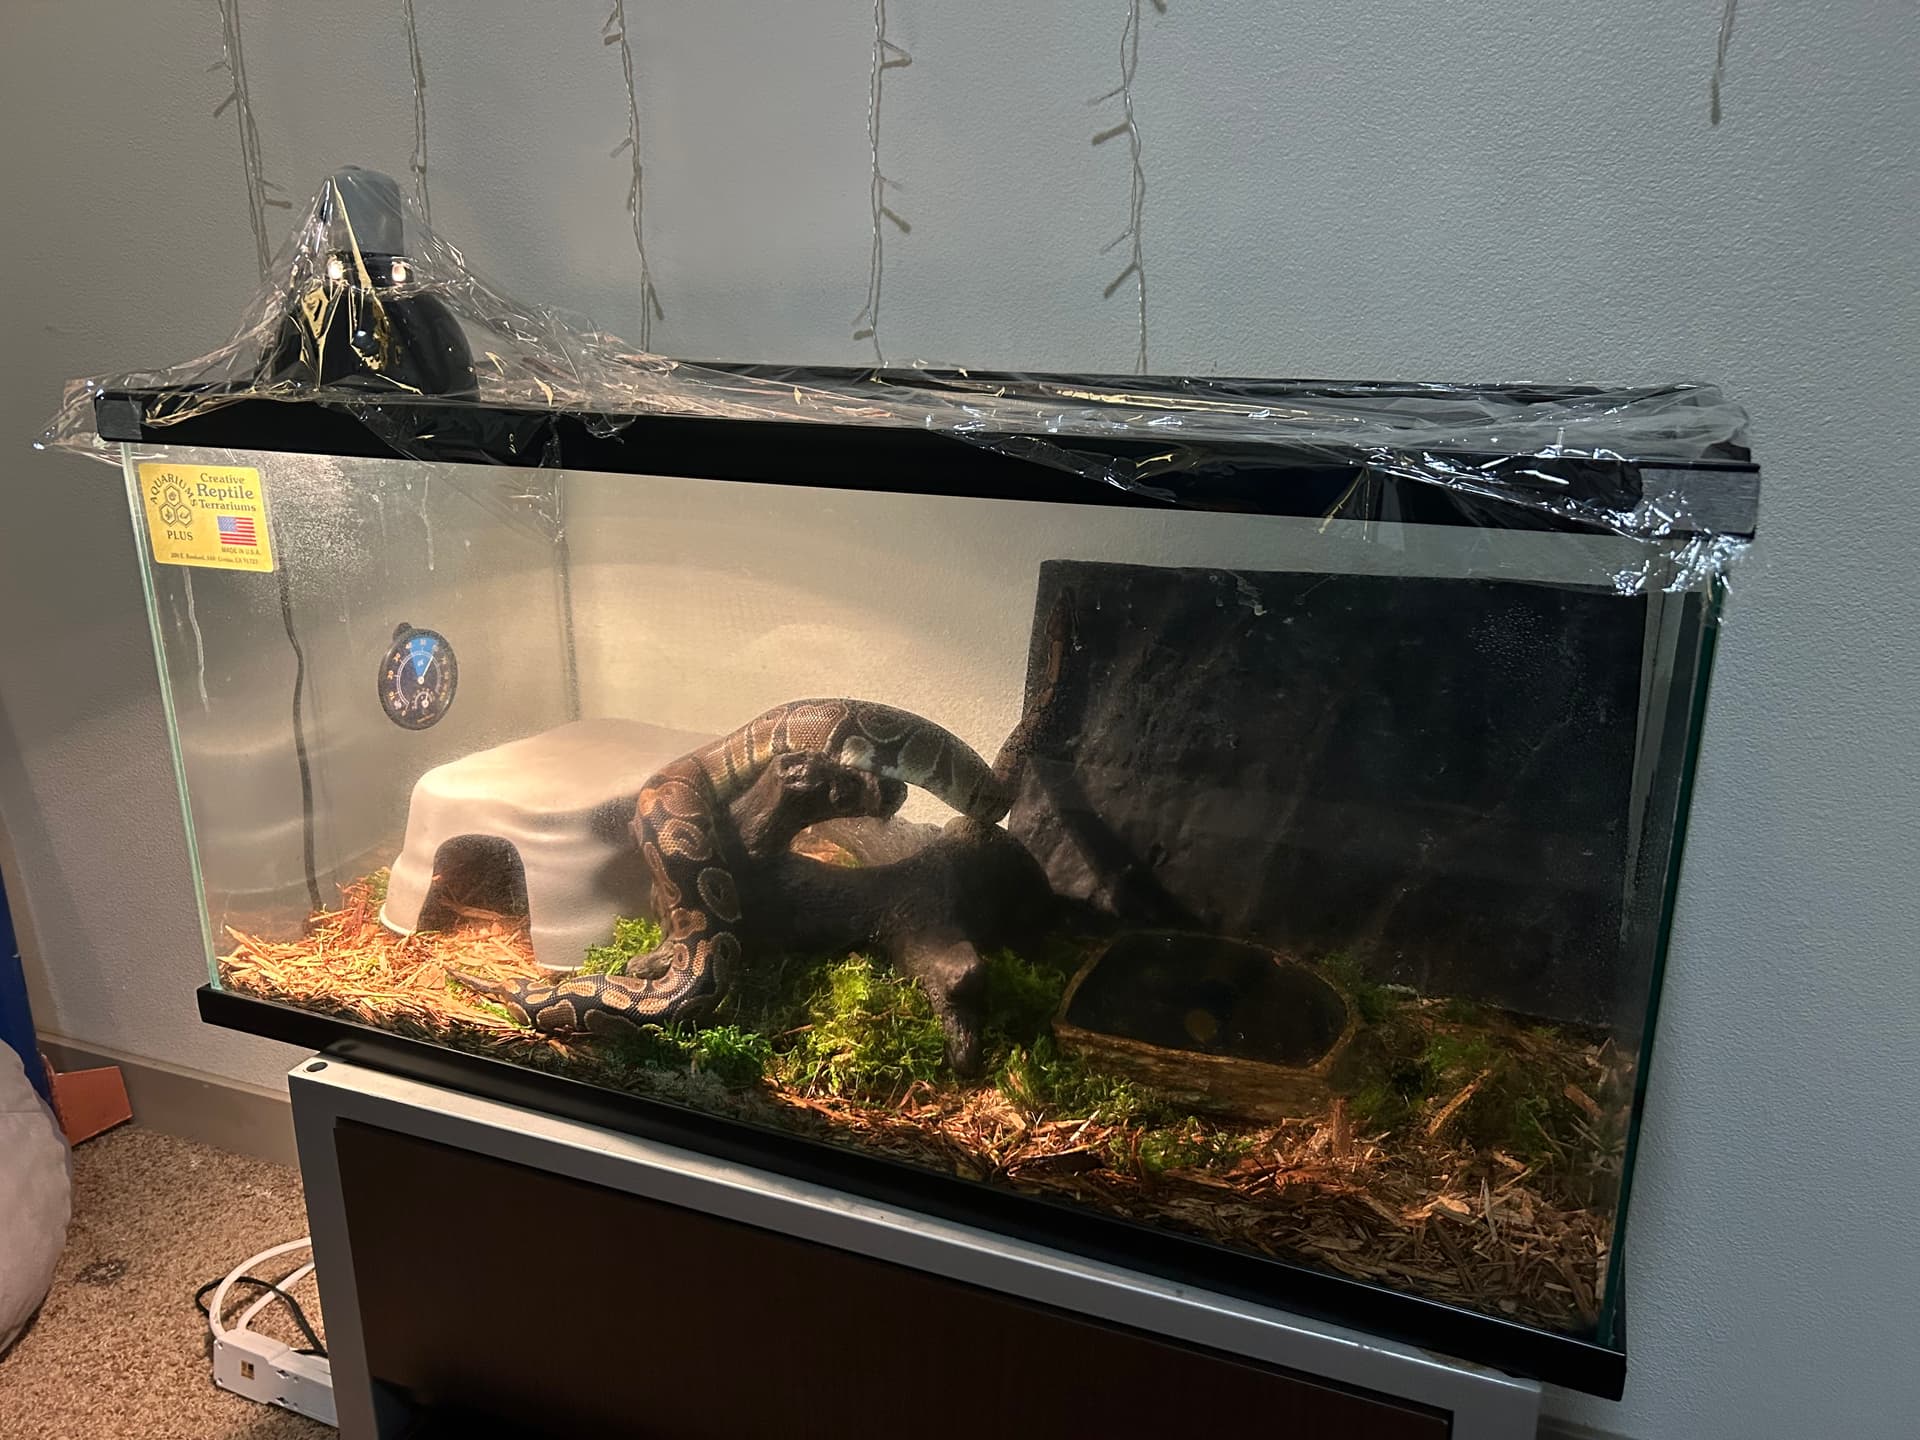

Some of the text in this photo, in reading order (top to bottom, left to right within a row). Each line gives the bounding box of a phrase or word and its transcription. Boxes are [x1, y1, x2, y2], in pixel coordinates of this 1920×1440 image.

[200, 472, 245, 485] Creative
[196, 483, 254, 500] Reptile
[198, 499, 257, 512] Terrariums
[166, 530, 194, 541] PLUS
[221, 546, 238, 554] MADE
